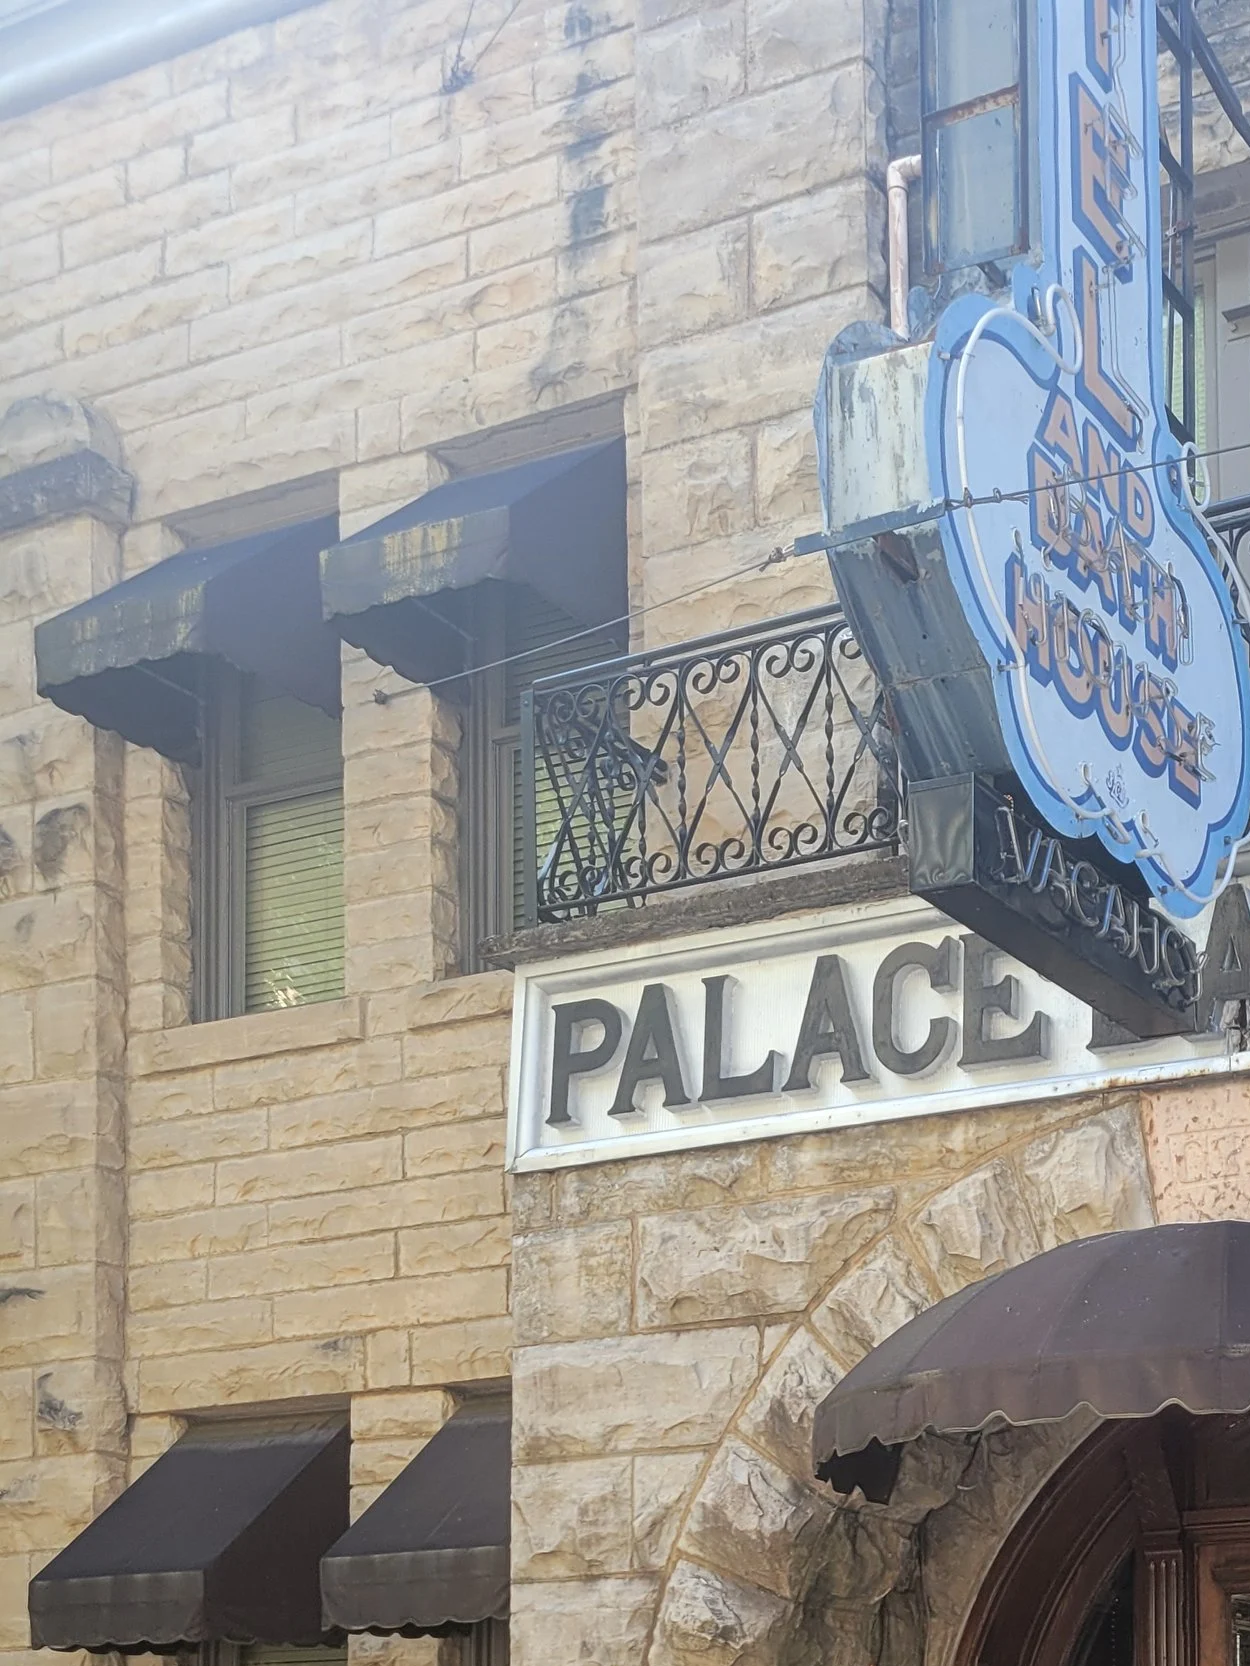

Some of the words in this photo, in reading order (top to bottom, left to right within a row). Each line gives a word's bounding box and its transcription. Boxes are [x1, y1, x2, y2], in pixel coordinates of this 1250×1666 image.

[1027, 442, 1180, 674] BATH
[1036, 385, 1155, 547] AND
[1005, 551, 1208, 811] HOUSE
[994, 806, 1208, 1006] VACANCY
[545, 933, 1047, 1126] PALACE
